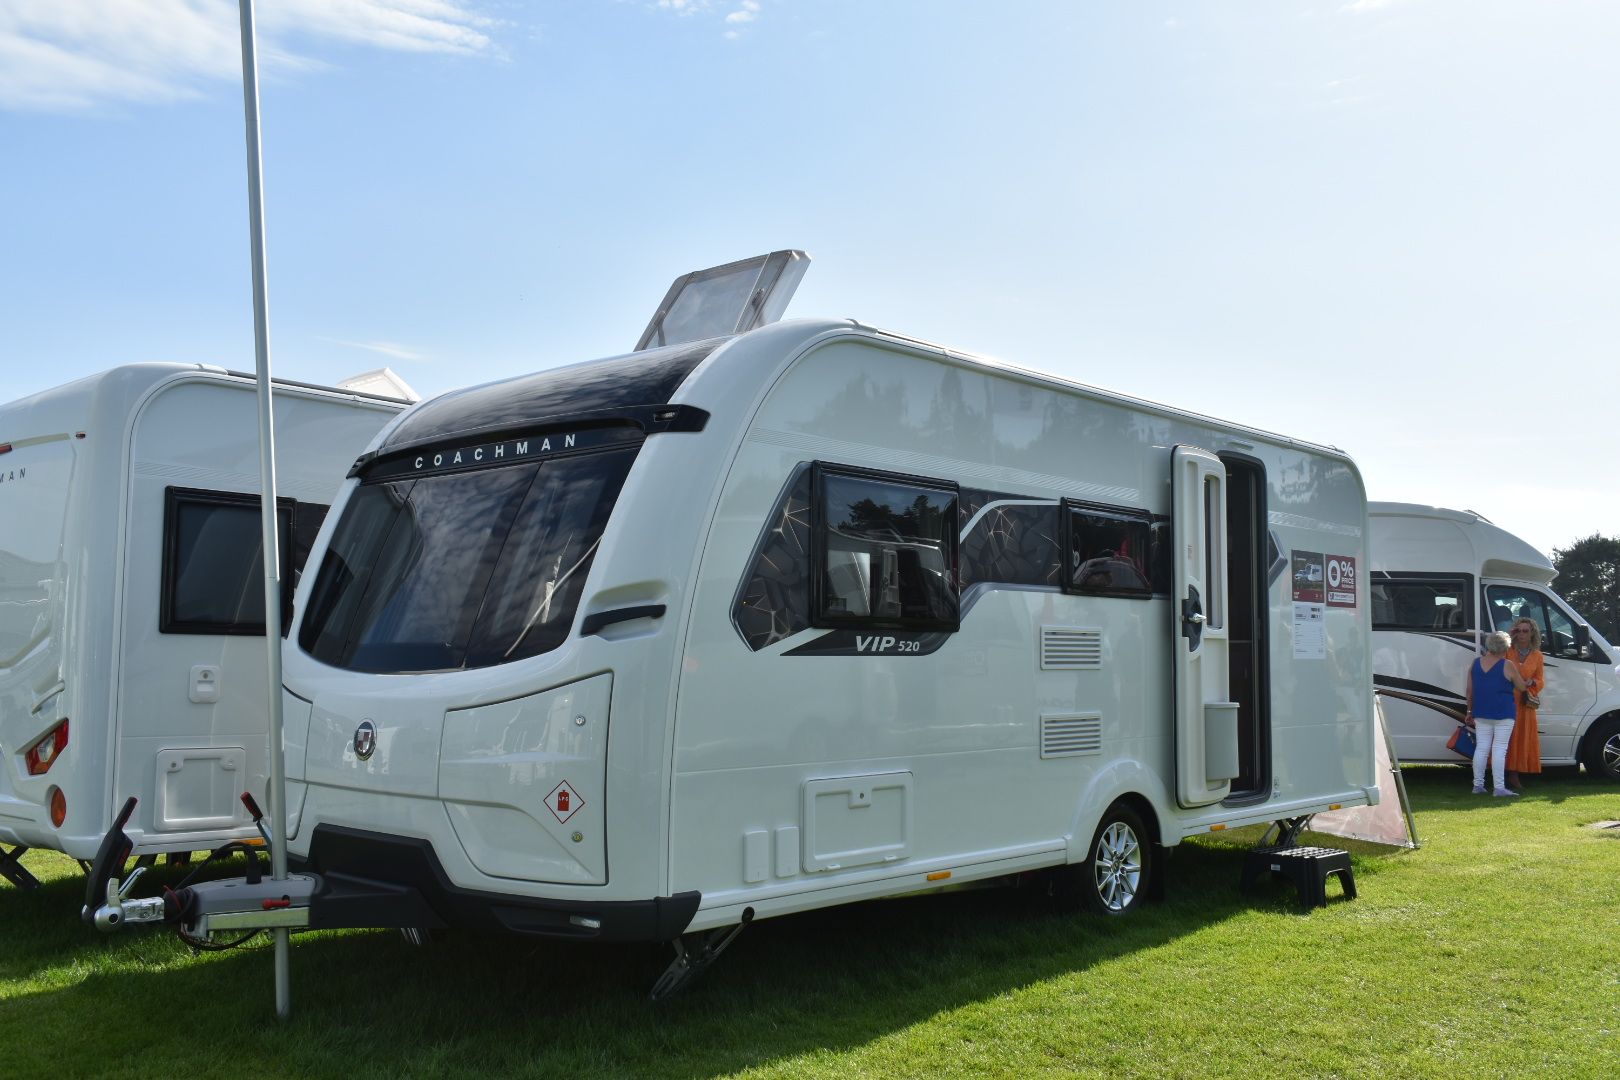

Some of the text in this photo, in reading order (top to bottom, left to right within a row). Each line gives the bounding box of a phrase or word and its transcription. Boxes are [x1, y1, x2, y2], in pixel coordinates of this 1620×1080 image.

[415, 433, 576, 469] COACHMAN
[855, 635, 920, 652] VIP 520
